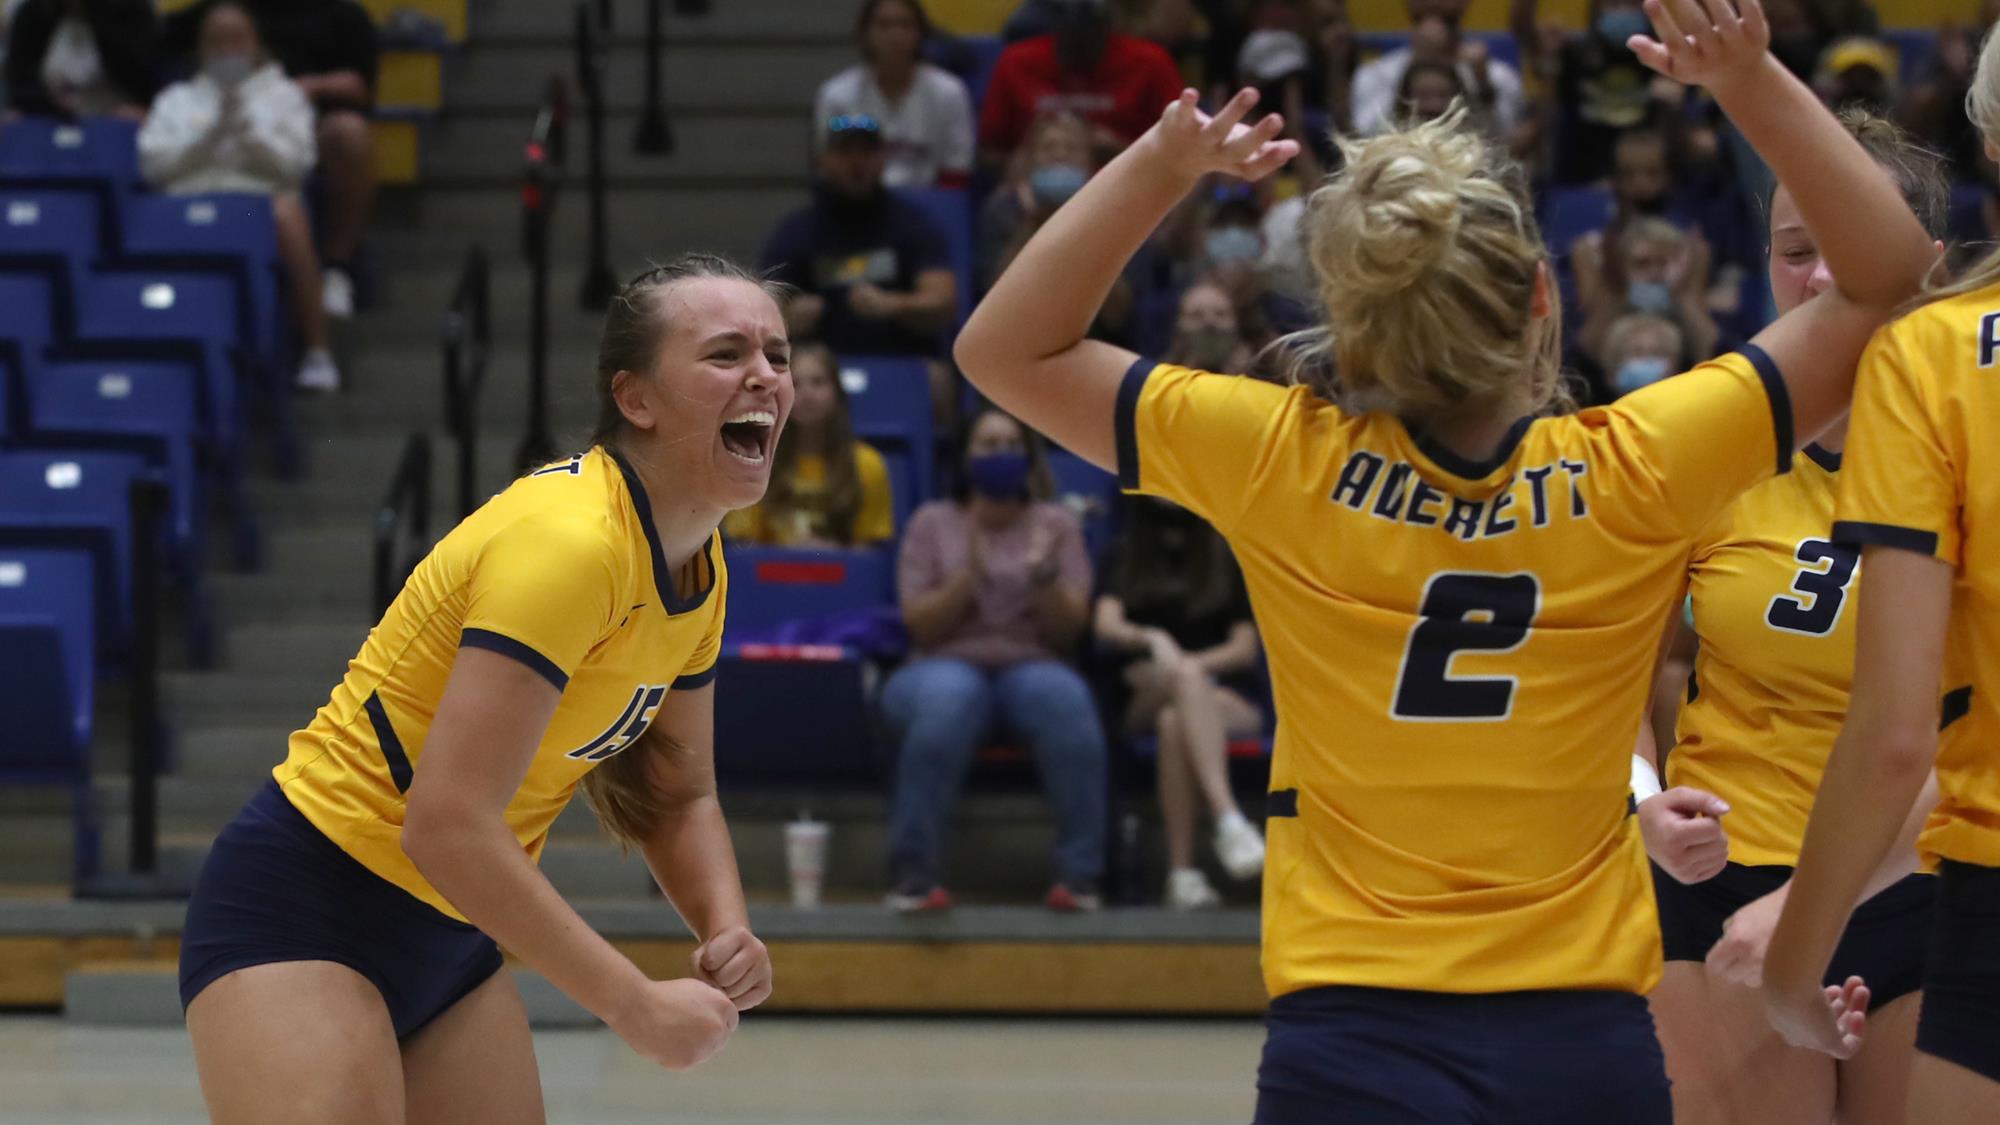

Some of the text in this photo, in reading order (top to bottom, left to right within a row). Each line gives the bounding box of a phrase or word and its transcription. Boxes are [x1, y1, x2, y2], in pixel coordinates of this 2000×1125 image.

[1331, 450, 1587, 540] AVERETT
[1764, 536, 1861, 637] 3
[1389, 569, 1543, 721] 2
[564, 684, 667, 762] 15
